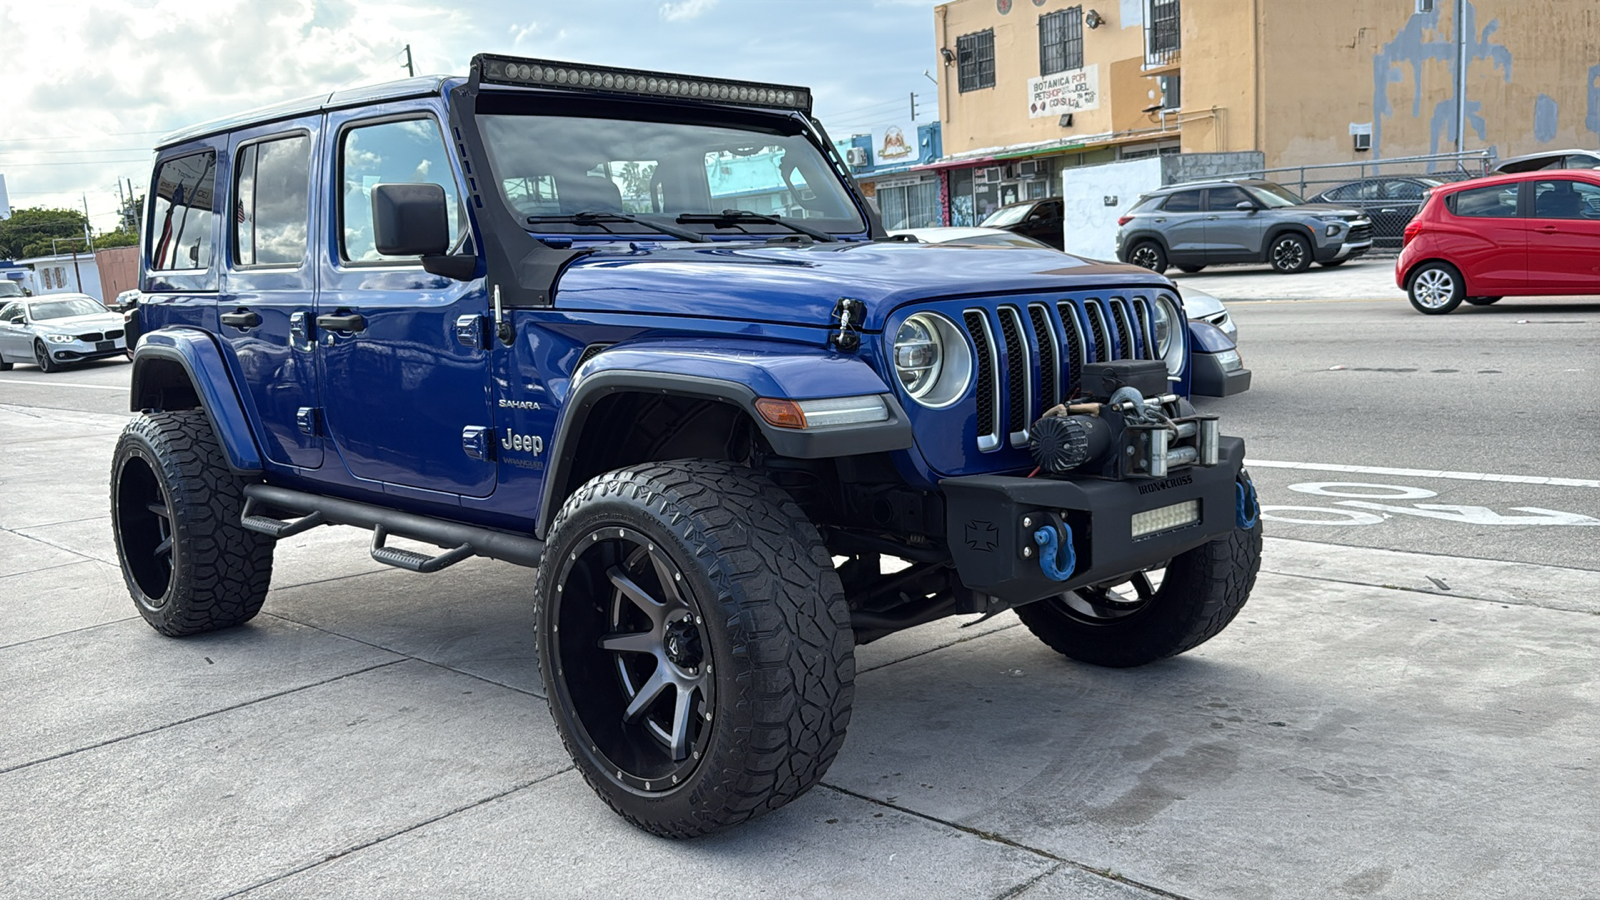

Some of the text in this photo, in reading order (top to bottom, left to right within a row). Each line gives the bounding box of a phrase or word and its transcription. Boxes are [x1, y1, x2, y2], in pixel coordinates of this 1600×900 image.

[1033, 77, 1069, 92] BOTANICA
[498, 399, 541, 410] SAHARA
[501, 428, 543, 457] Jeep
[503, 457, 543, 469] WRANGLER
[1138, 474, 1193, 495] IRON CROSS
